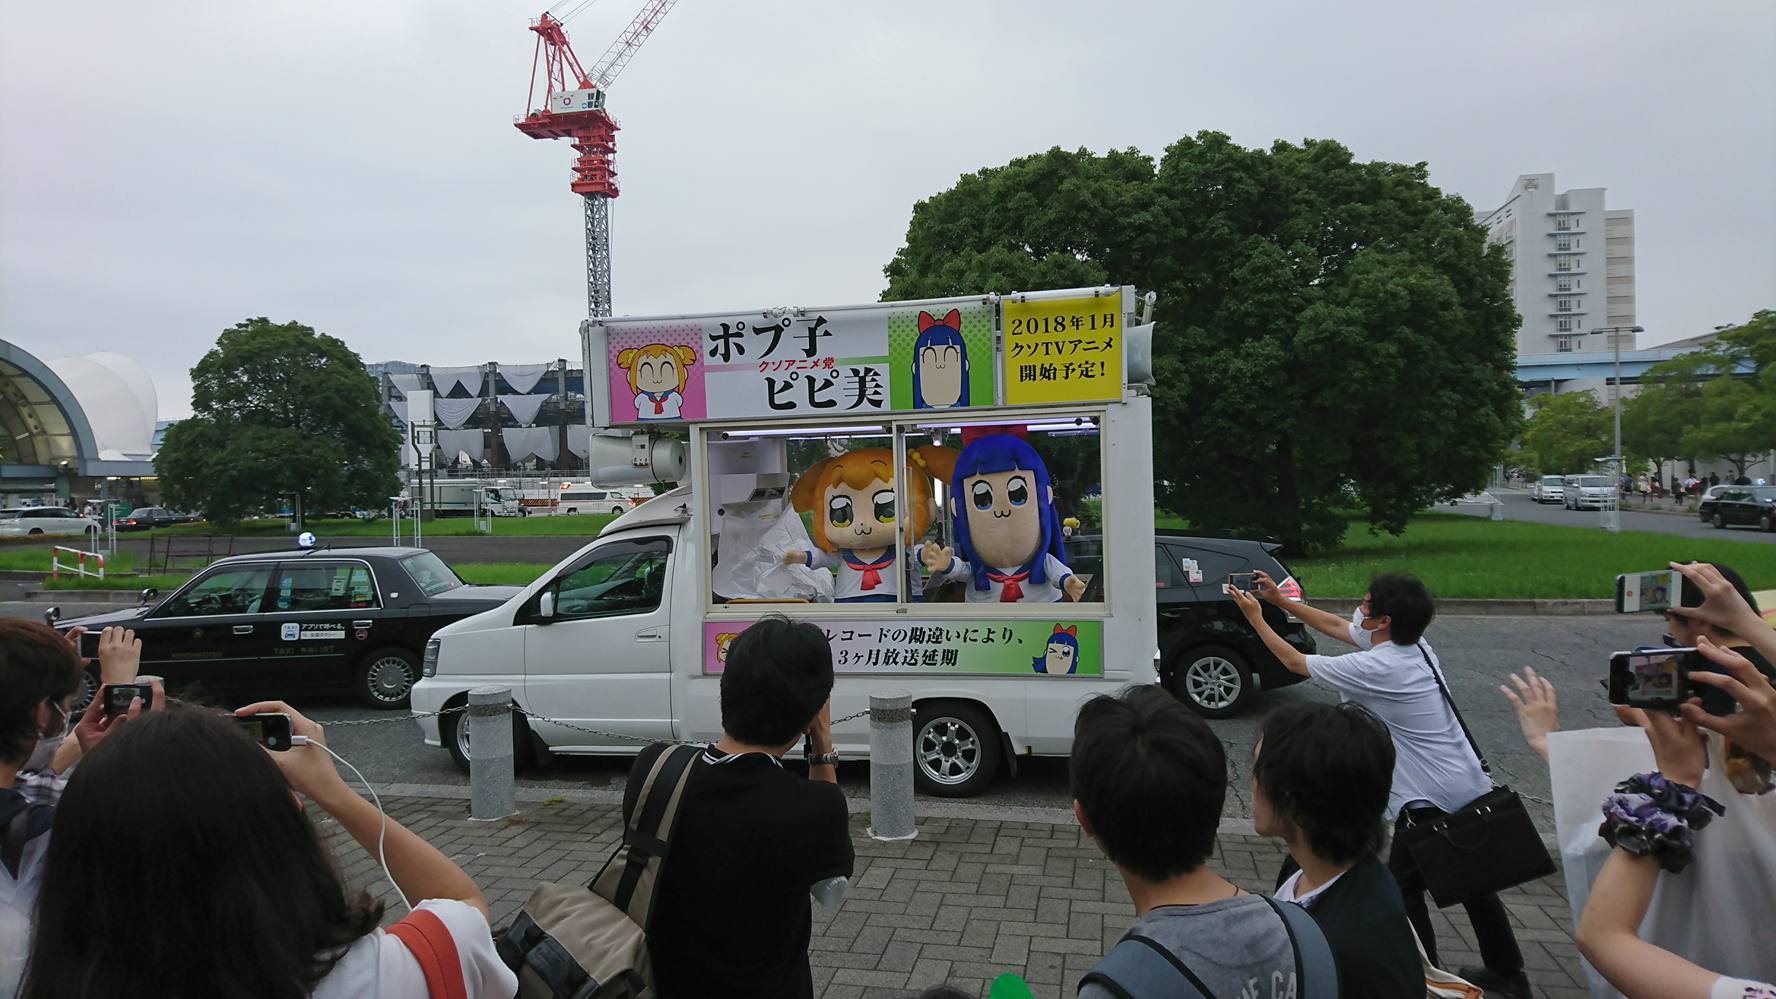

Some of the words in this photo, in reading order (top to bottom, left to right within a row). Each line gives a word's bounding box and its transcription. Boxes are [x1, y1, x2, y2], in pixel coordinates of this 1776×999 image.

[1011, 313, 1115, 336] 2018年1月
[709, 315, 833, 363] ポプ子
[1011, 337, 1113, 359] クソTVアニメ
[759, 356, 835, 373] クソアニメ党
[1020, 361, 1105, 383] 開始予定!
[764, 367, 884, 411] ピピ美
[821, 626, 1023, 644] レコードの勘違いにより、
[838, 648, 959, 667] 3ヶ月放送延期
